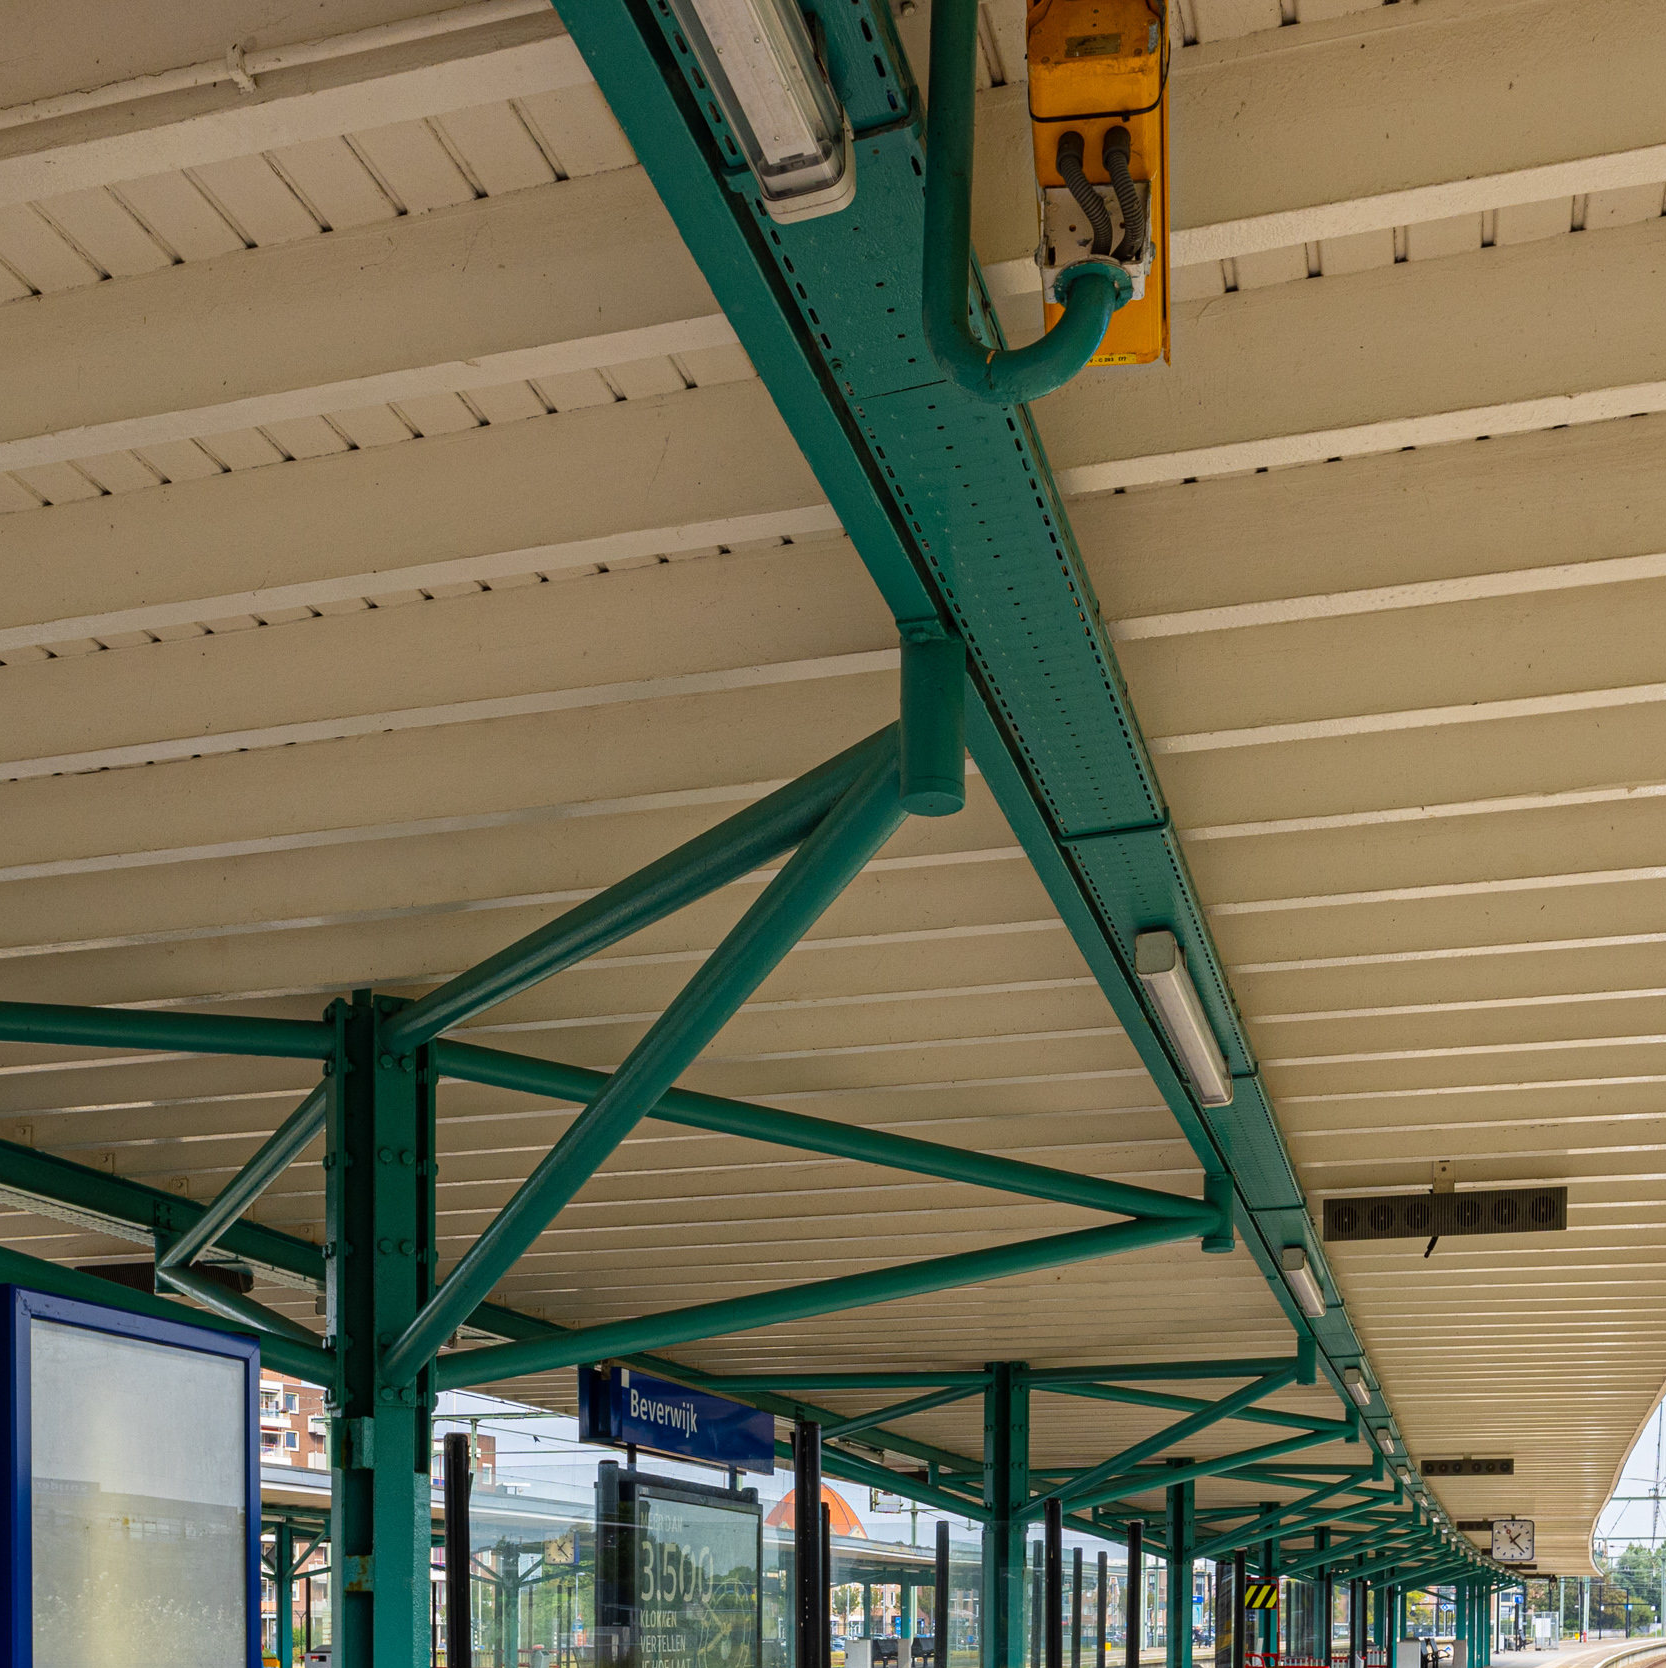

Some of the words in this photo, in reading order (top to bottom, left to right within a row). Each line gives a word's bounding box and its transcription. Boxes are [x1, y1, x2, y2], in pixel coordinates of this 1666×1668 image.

[630, 1388, 698, 1438] Beverwijk
[640, 1510, 663, 1532] MEER
[665, 1515, 683, 1533] DAN
[640, 1540, 714, 1603] 3.500
[639, 1609, 677, 1629] KLOKKEN
[639, 1634, 686, 1654] VERTELLEN
